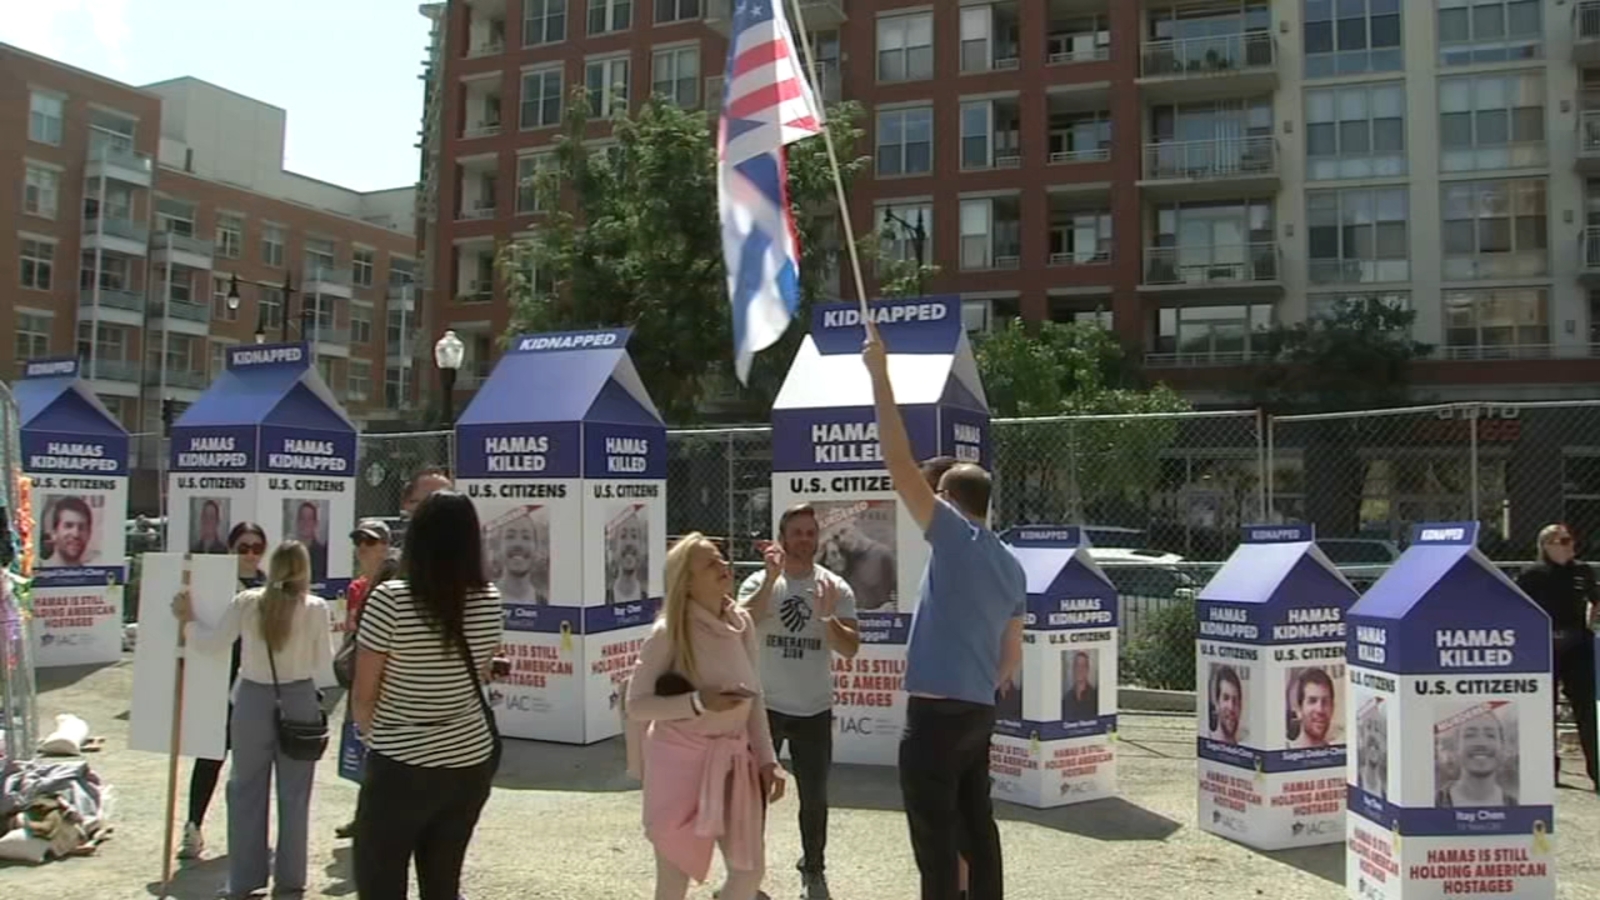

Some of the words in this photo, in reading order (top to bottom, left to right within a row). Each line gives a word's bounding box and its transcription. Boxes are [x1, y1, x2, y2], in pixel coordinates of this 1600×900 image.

[823, 303, 947, 327] KIDNAPPED
[519, 333, 617, 350] KIDNAPPED
[232, 348, 302, 365] KIDNAPPED
[27, 361, 76, 376] KIDNAPPED
[811, 423, 880, 443] HAMA
[952, 422, 980, 443] HAMAS
[47, 442, 104, 457] HAMAS
[190, 437, 235, 451] HAMAS
[284, 439, 333, 455] HAMAS
[485, 436, 549, 453] HAMAS
[605, 437, 648, 455] HAMAS
[178, 452, 247, 467] KIDNAPPED
[815, 444, 881, 463] KILLE
[955, 444, 980, 463] KILLED
[30, 456, 118, 471] KIDNAPPED
[269, 454, 346, 471] KIDNAPPED
[488, 455, 546, 472] KILLED
[607, 456, 646, 473] KILLED
[31, 478, 56, 489] U.S.
[60, 479, 116, 490] CITIZENS
[177, 477, 198, 489] U.S.
[200, 477, 246, 489] CITIZENS
[269, 479, 293, 491] U.S.
[295, 480, 345, 492] CITIZENS
[790, 477, 827, 493] U.S.
[831, 475, 892, 492] CITIZE
[468, 485, 497, 498] U.S.
[499, 484, 567, 498] CITIZENS
[594, 485, 615, 498] U.S.
[617, 485, 658, 498] CITIZENS
[1020, 530, 1068, 540] KIDNAPPED
[1252, 529, 1300, 540] KIDNAPPED
[1421, 528, 1465, 540] KIDNAPPED
[1060, 599, 1100, 611] HAMAS
[1049, 611, 1112, 625] KIDNAPPED
[1210, 607, 1247, 622] HAMAS
[1288, 608, 1340, 623] HAMAS
[894, 618, 903, 628] &
[1200, 621, 1258, 639] KIDNAPPED
[1050, 634, 1068, 643] U.S.
[1070, 631, 1111, 641] CITIZENS
[1273, 623, 1346, 640] KIDNAPPE
[1356, 625, 1386, 645] HAMAS
[1436, 630, 1515, 647] HAMAS
[518, 645, 528, 656] IS
[530, 645, 559, 659] STILL
[1201, 645, 1217, 654] U.S.
[1217, 645, 1258, 660] CITIZENS
[1275, 648, 1298, 661] U.S.
[1358, 644, 1386, 664] KILLED
[1440, 650, 1512, 667] KILLED
[516, 660, 573, 675] AMERICAN
[856, 660, 869, 673] IS
[1363, 673, 1395, 693] CITIZENS
[1415, 680, 1450, 694] U.S.
[1456, 679, 1538, 694] CITIZENS
[506, 695, 530, 711] IAC
[832, 692, 893, 707] OSTAGES
[840, 717, 872, 735] IAC
[1283, 781, 1315, 793] HAMAS
[1271, 795, 1311, 807] HOLDING
[1294, 802, 1339, 815] HOSTAGES
[1456, 811, 1475, 822] Itay
[1478, 810, 1506, 820] Chen
[1428, 850, 1475, 863] HAMAS
[1479, 850, 1490, 862] IS
[1495, 849, 1528, 861] STILL
[1410, 867, 1472, 879] HOLDING
[1475, 864, 1546, 878] AMERICAN
[1444, 881, 1513, 893] HOSTAGES
